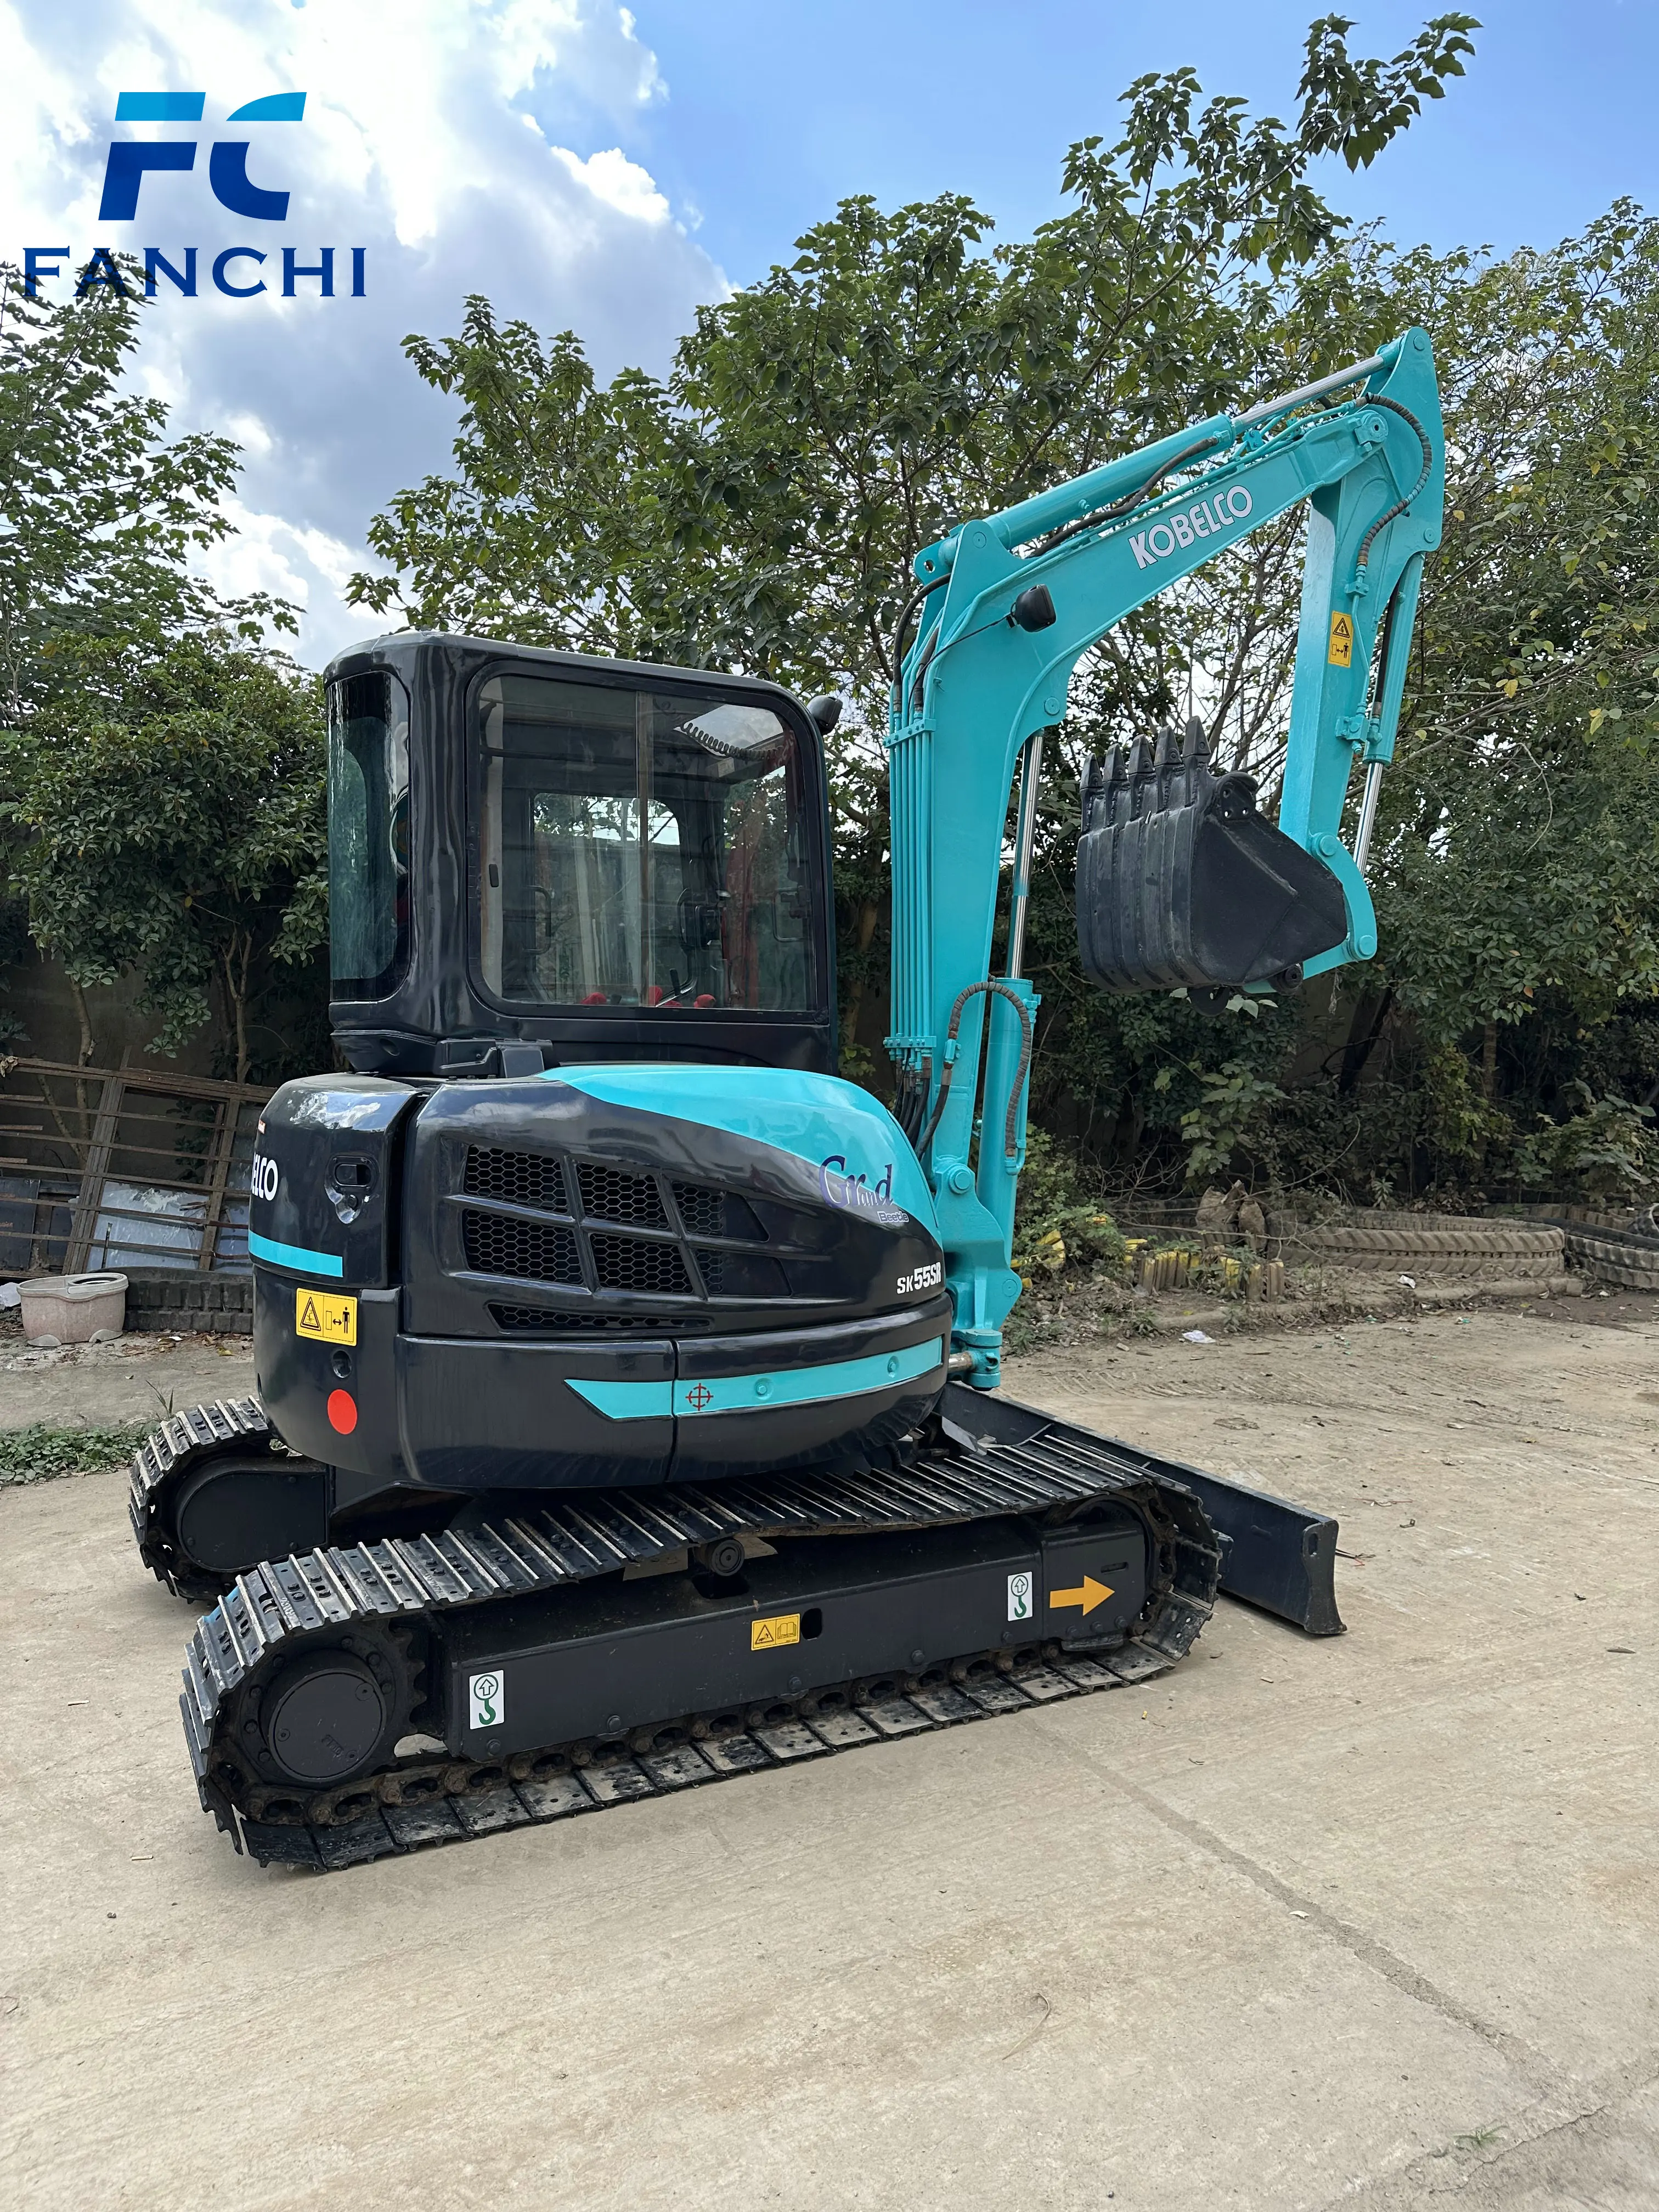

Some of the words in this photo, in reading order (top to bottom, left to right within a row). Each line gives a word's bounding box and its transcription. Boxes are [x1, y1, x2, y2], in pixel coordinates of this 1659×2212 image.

[1128, 485, 1253, 570] KOBELCO
[251, 1152, 278, 1201] ELCO
[878, 1211, 909, 1223] Beetle
[896, 1262, 941, 1295] SK55SR
